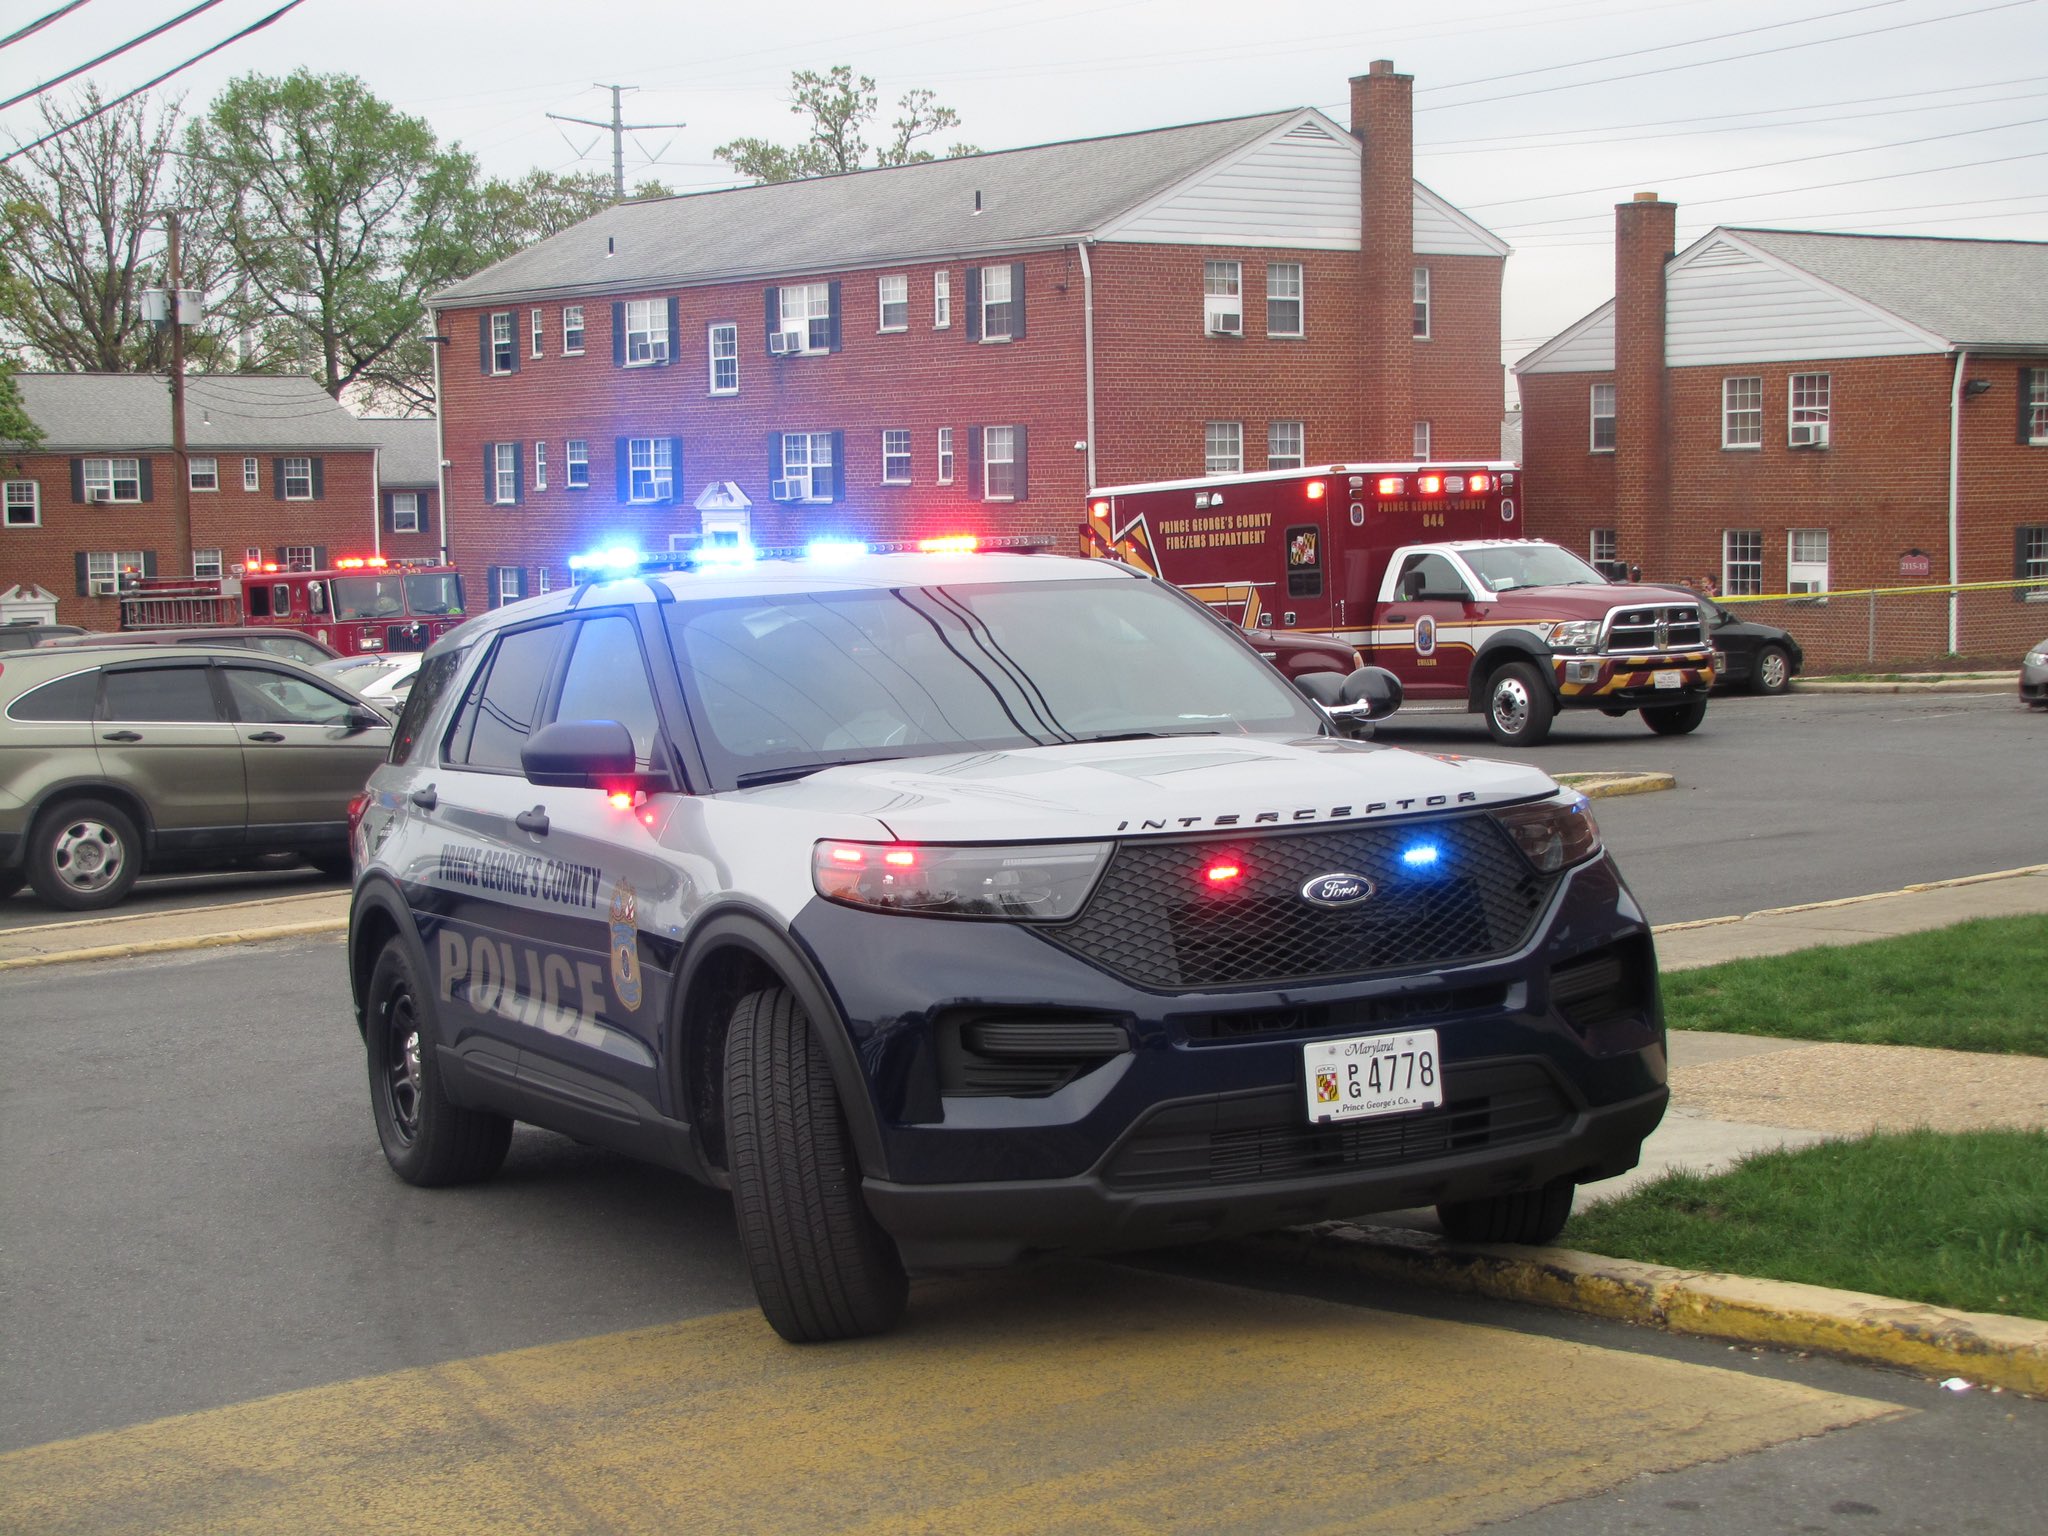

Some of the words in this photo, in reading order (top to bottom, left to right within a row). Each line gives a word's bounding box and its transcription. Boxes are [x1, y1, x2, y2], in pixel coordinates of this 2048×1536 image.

[1377, 502, 1408, 512] PRINCE
[1159, 520, 1190, 534] PRINCE
[1192, 516, 1233, 532] GEORGE'S
[1236, 513, 1272, 528] COUNTY
[1423, 514, 1444, 527] 844
[1166, 534, 1207, 550] FIRE/EMS
[1209, 530, 1266, 547] DEPARTMENT
[1117, 791, 1477, 830] INTERCEPTOR
[439, 844, 482, 886] PRINCE
[481, 850, 543, 898] GEORGE'S
[542, 859, 602, 909] COUNTY
[1322, 879, 1359, 898] Ford
[439, 929, 606, 1046] POLICE
[1345, 1038, 1394, 1057] Maryland
[1368, 1051, 1434, 1094] 4778
[1342, 1102, 1365, 1113] Prince
[1366, 1098, 1396, 1110] George's
[1397, 1096, 1410, 1105] Co.
